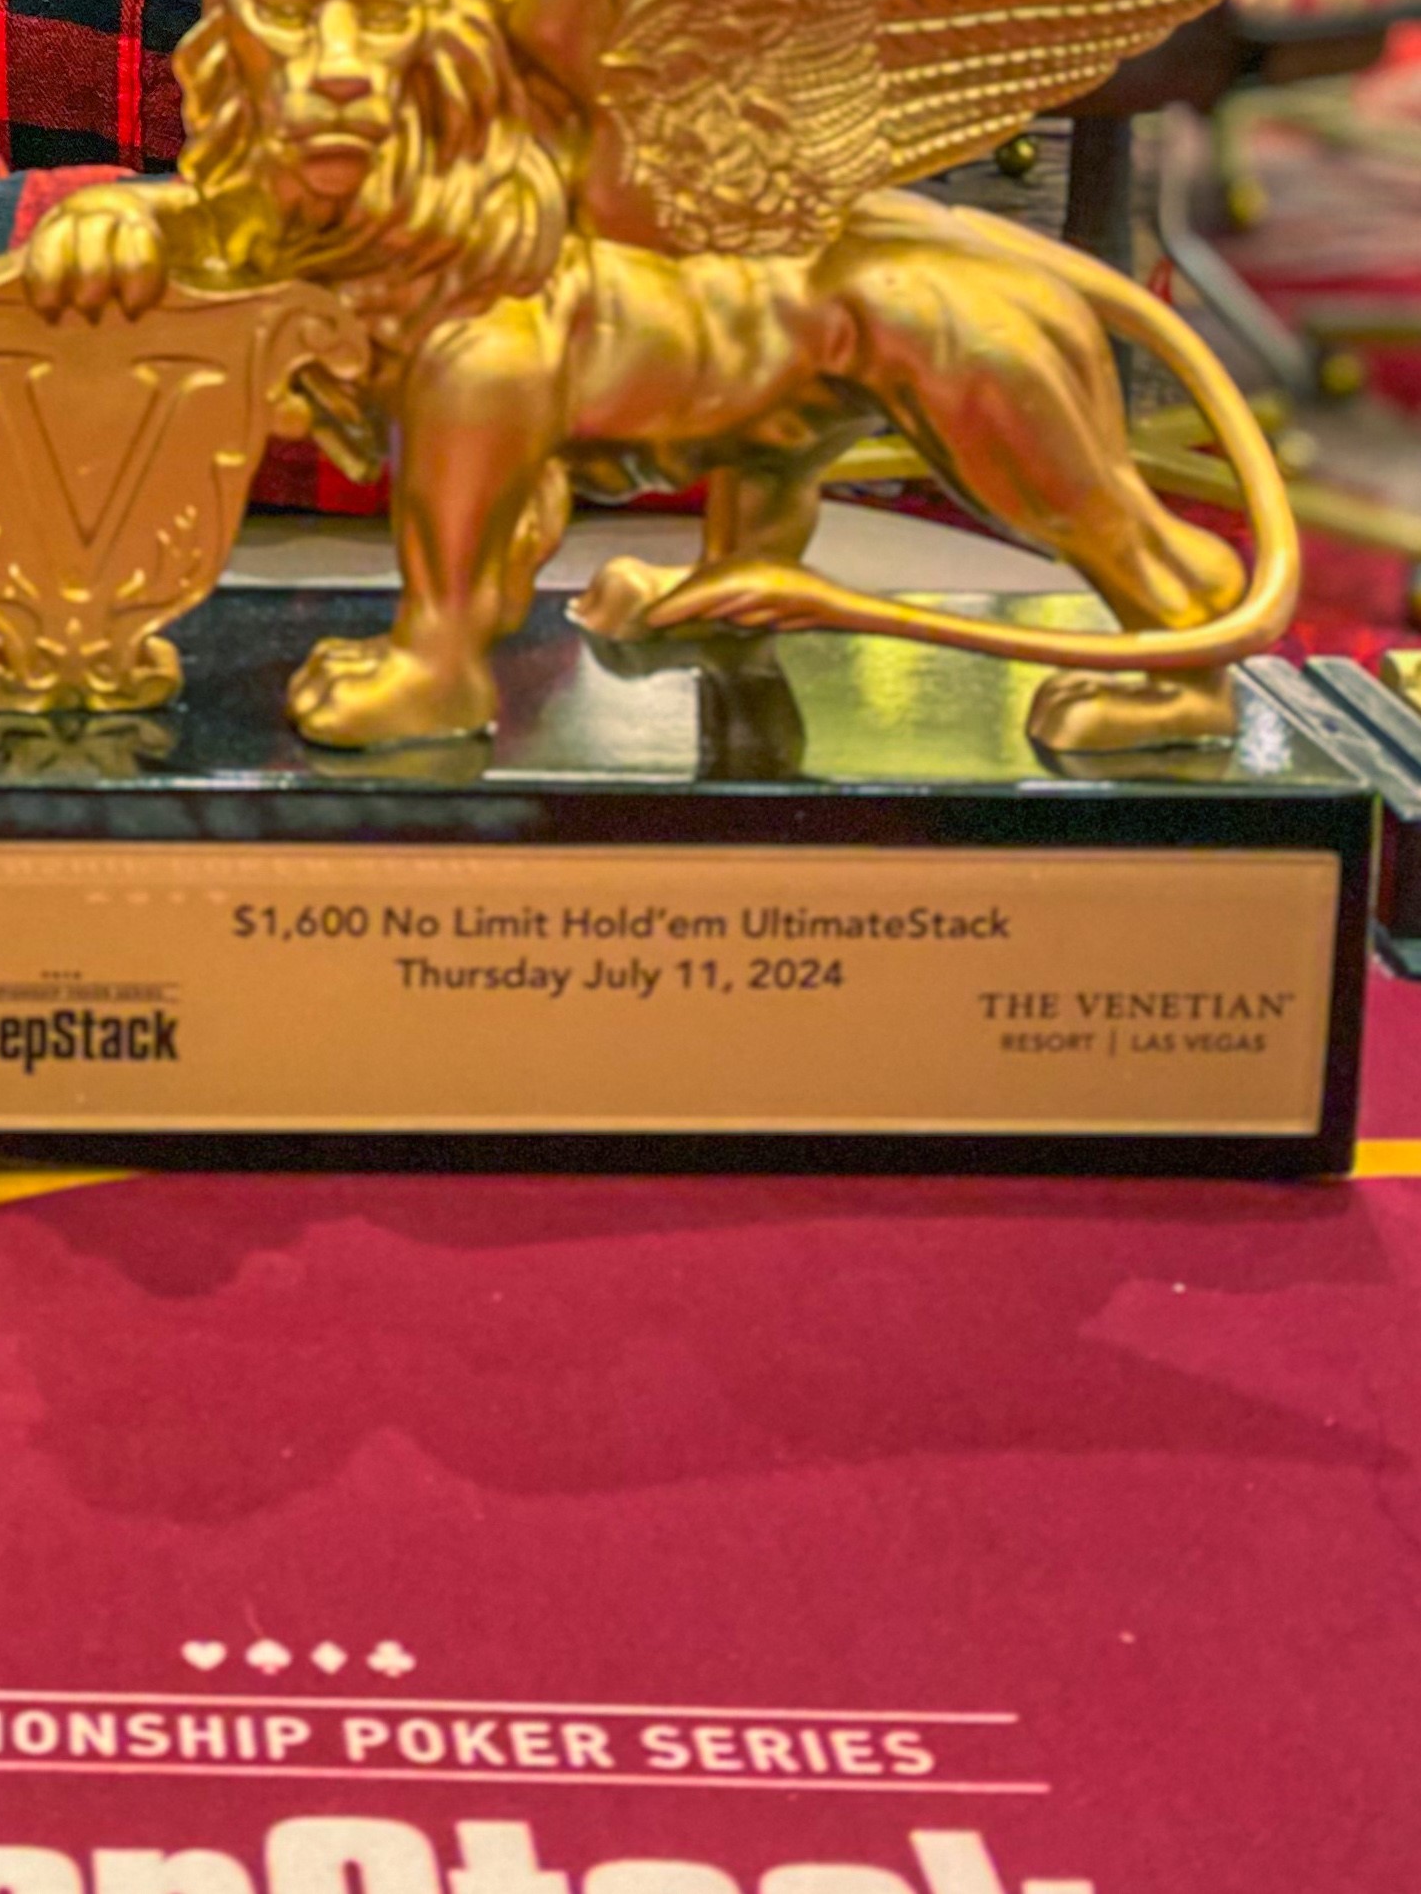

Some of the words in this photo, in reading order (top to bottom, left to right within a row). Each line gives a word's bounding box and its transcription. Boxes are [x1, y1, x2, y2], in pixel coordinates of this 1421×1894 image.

[232, 905, 369, 941] $1,600
[382, 906, 440, 939] No
[454, 907, 548, 939] Limit
[741, 907, 1010, 939] UltimateStack
[395, 957, 572, 998] Thursday
[582, 958, 661, 999] July
[675, 959, 733, 993] 11,
[747, 959, 845, 990] 2024
[978, 991, 1059, 1020] THE
[1000, 1032, 1095, 1052] RESORT
[1131, 1033, 1176, 1052] LAS
[1183, 1034, 1266, 1052] VEGAS
[343, 1718, 616, 1769] POKER
[640, 1725, 936, 1775] SERIES
